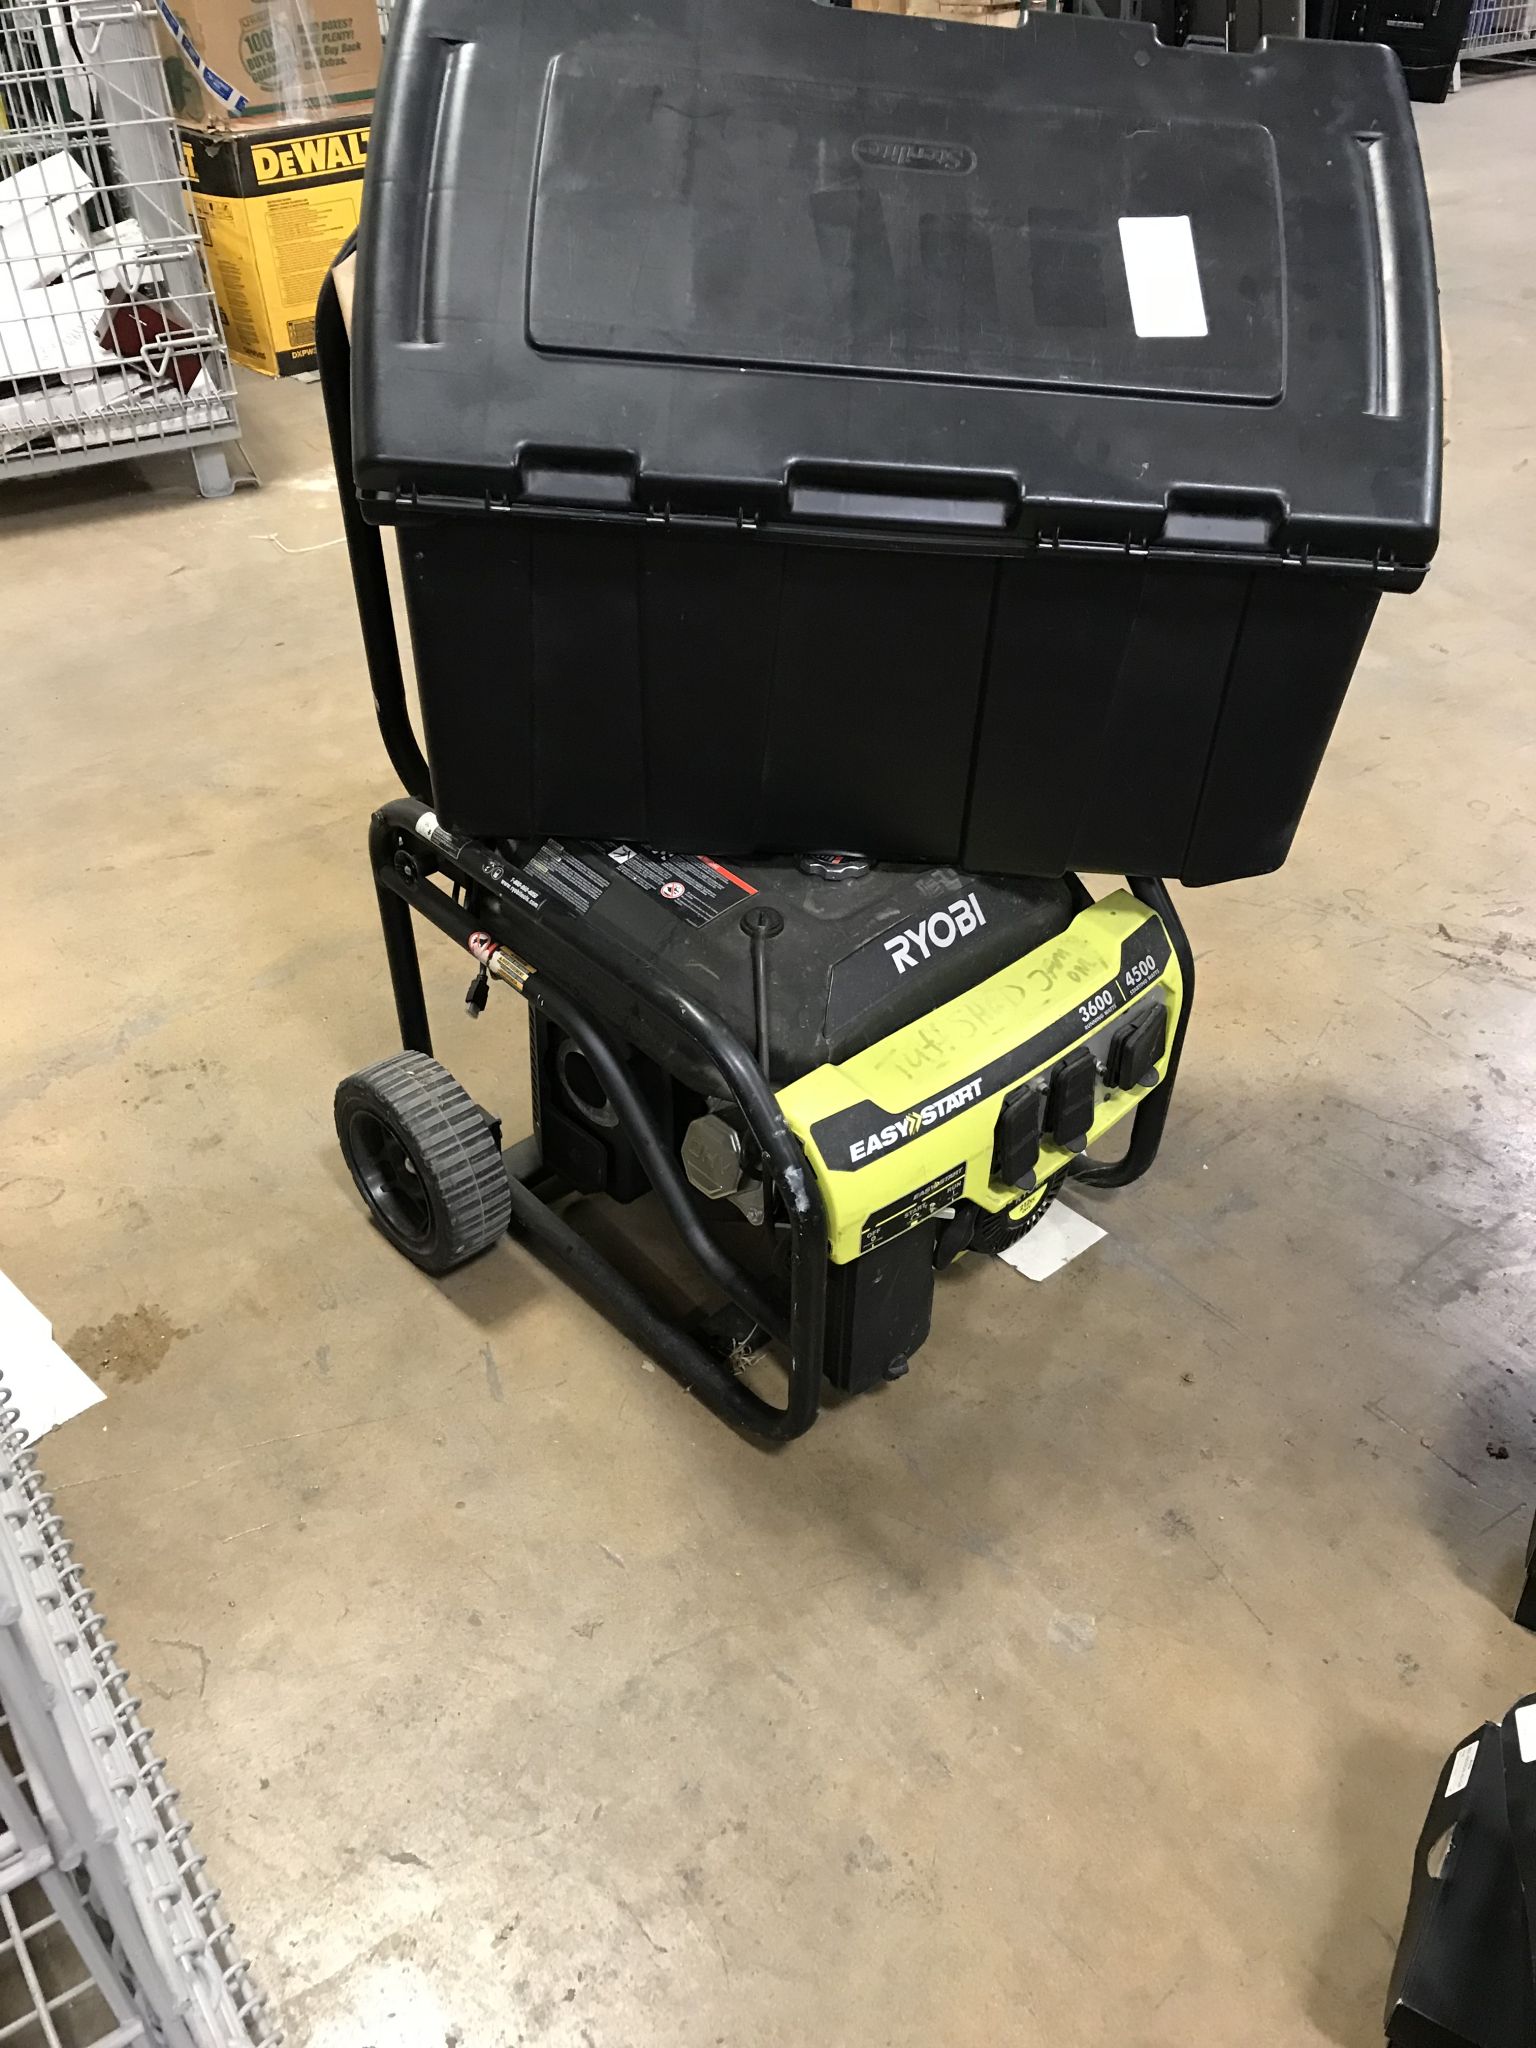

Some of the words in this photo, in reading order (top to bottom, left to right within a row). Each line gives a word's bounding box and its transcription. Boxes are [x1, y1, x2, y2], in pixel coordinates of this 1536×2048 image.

[244, 28, 274, 55] 100
[292, 348, 317, 359] DXPW
[883, 892, 987, 975] RYOBI
[1125, 954, 1156, 987] 4500
[1079, 989, 1113, 1023] 3600
[920, 1077, 983, 1126] START
[867, 1228, 881, 1239] OFF
